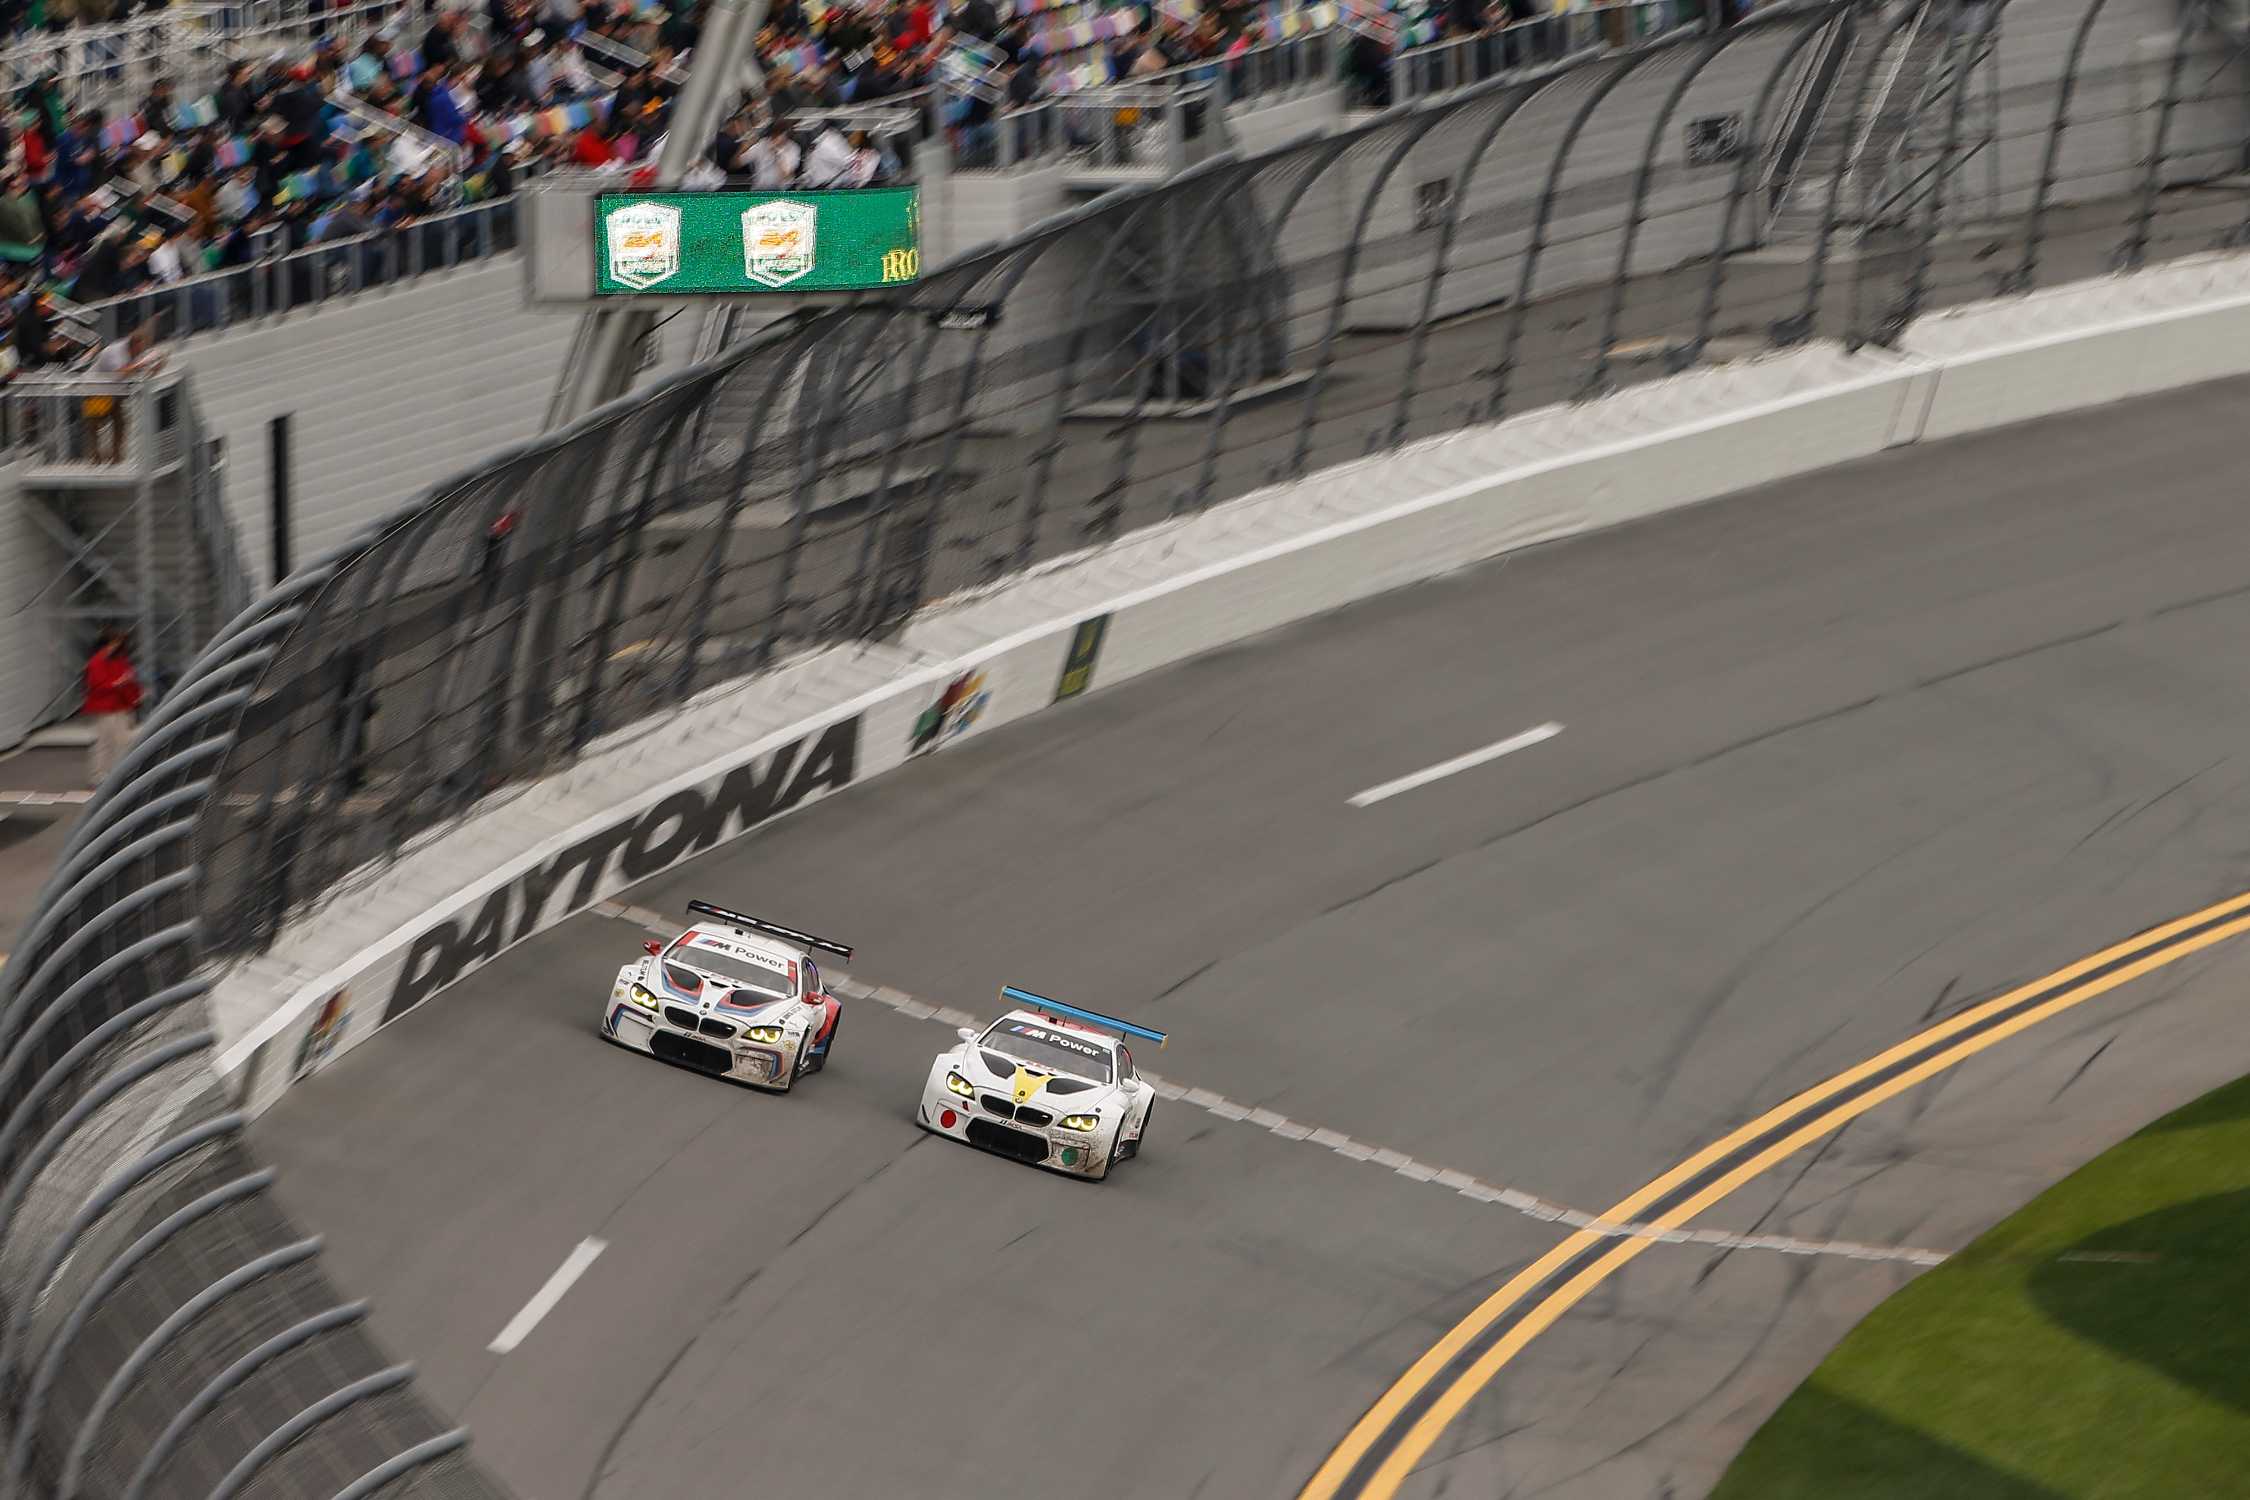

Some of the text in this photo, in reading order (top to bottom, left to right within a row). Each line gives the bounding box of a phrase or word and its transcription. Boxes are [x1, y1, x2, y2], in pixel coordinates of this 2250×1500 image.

[382, 714, 860, 1025] DAYTONA
[735, 946, 786, 968] Power
[1049, 1034, 1100, 1057] Power
